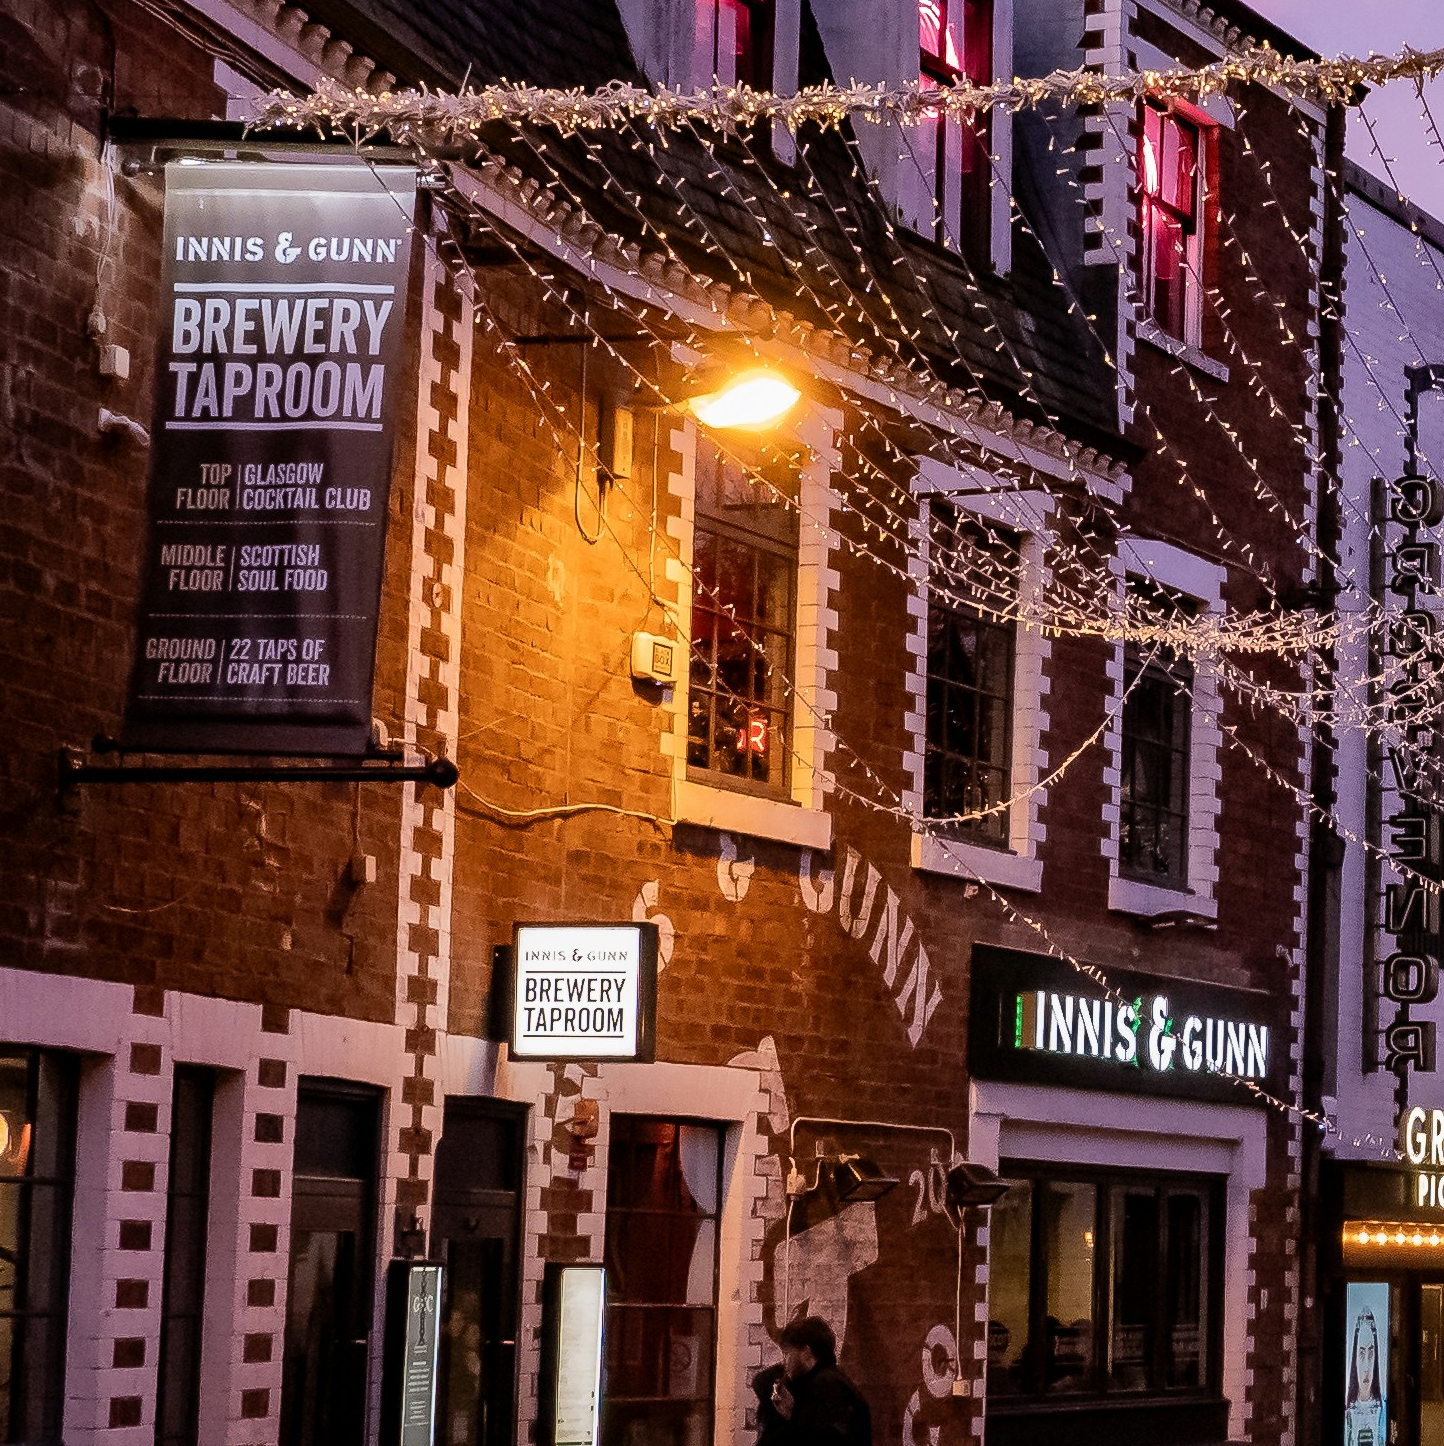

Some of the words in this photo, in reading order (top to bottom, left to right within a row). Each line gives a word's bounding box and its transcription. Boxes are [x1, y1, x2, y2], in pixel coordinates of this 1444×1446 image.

[175, 235, 264, 263] INNIS
[274, 231, 303, 264] &
[308, 237, 396, 263] GUNN
[173, 298, 394, 356] BREWERY
[168, 361, 385, 419] TAPROOM
[200, 464, 232, 485] TOP
[243, 463, 324, 486] GLASGOW
[176, 488, 230, 510] FLOOR
[242, 488, 320, 511] COCKTAIL
[325, 488, 371, 511] CLUB
[161, 545, 226, 567] MIDDLE
[240, 544, 320, 567] SCOTTISH
[168, 568, 224, 591] FLOOR
[237, 568, 279, 591] SOUL
[283, 568, 328, 591] FOOD
[145, 638, 216, 661] GROUND
[229, 638, 251, 661] 22
[257, 637, 298, 661] TAPS
[302, 638, 325, 661] OF
[157, 662, 213, 686] FLOOR
[226, 662, 281, 686] CRAFT
[285, 662, 330, 686] BEER
[525, 949, 568, 963] INNIS
[571, 947, 584, 964] &
[587, 950, 629, 963] GUNN
[525, 977, 627, 1004] BREWERY
[523, 1006, 624, 1033] TAPROOM
[1035, 990, 1136, 1063] INNIS
[1149, 995, 1177, 1072] &
[1182, 1014, 1268, 1078] GUNN
